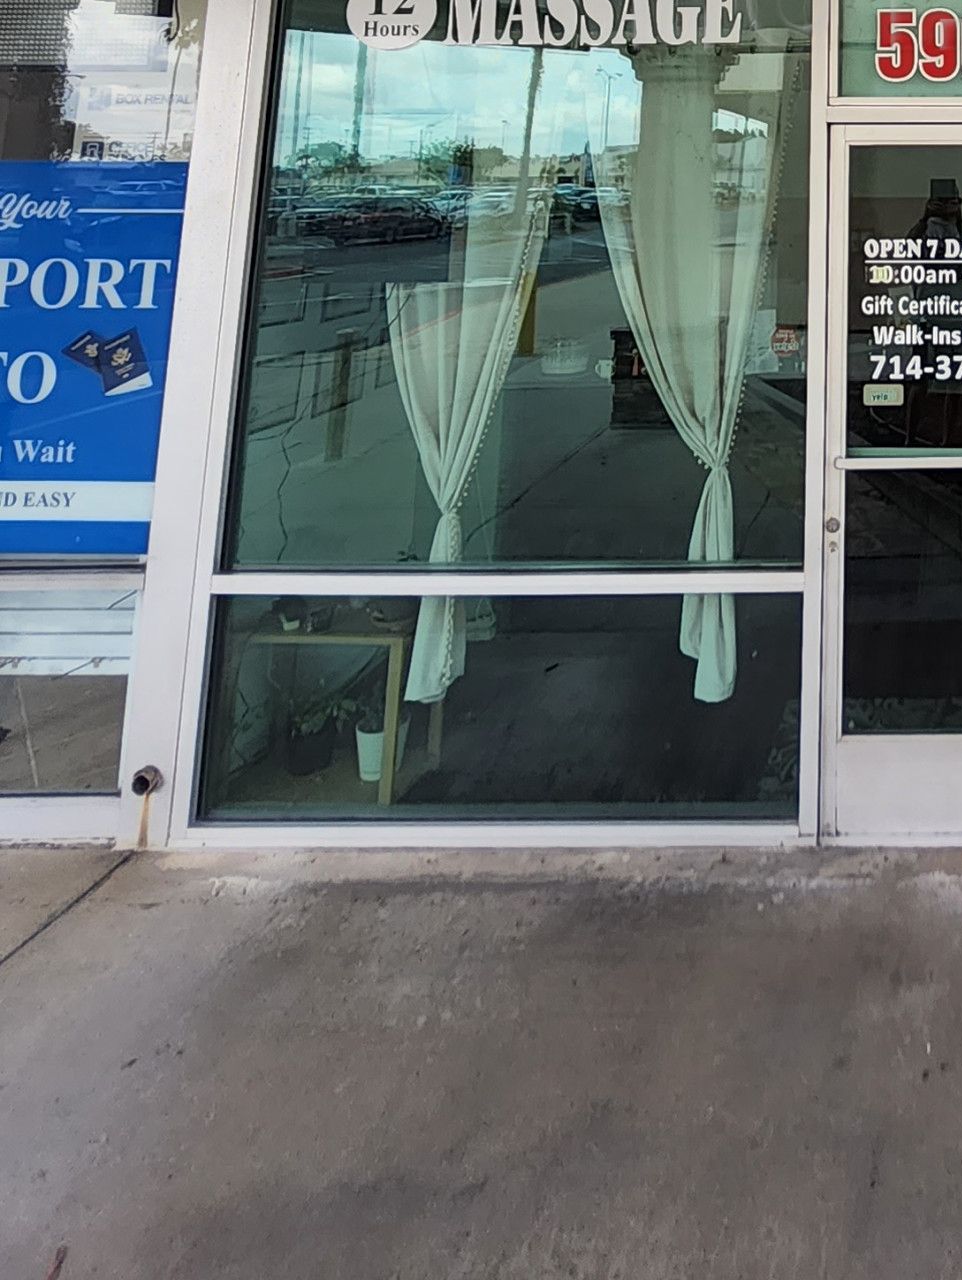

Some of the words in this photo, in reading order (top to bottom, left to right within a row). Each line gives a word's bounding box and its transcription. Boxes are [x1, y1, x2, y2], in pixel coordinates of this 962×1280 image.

[363, 21, 420, 39] Hours
[115, 93, 142, 105] BOX
[0, 193, 73, 231] Your
[864, 238, 923, 259] OPEN
[926, 238, 938, 259] 7
[868, 265, 957, 284] 10:00am
[861, 295, 894, 315] Gift
[873, 324, 962, 345] Walk-Ins
[0, 351, 57, 404] O
[13, 439, 77, 463] Wait
[0, 491, 17, 507] D
[22, 491, 76, 508] EASY
